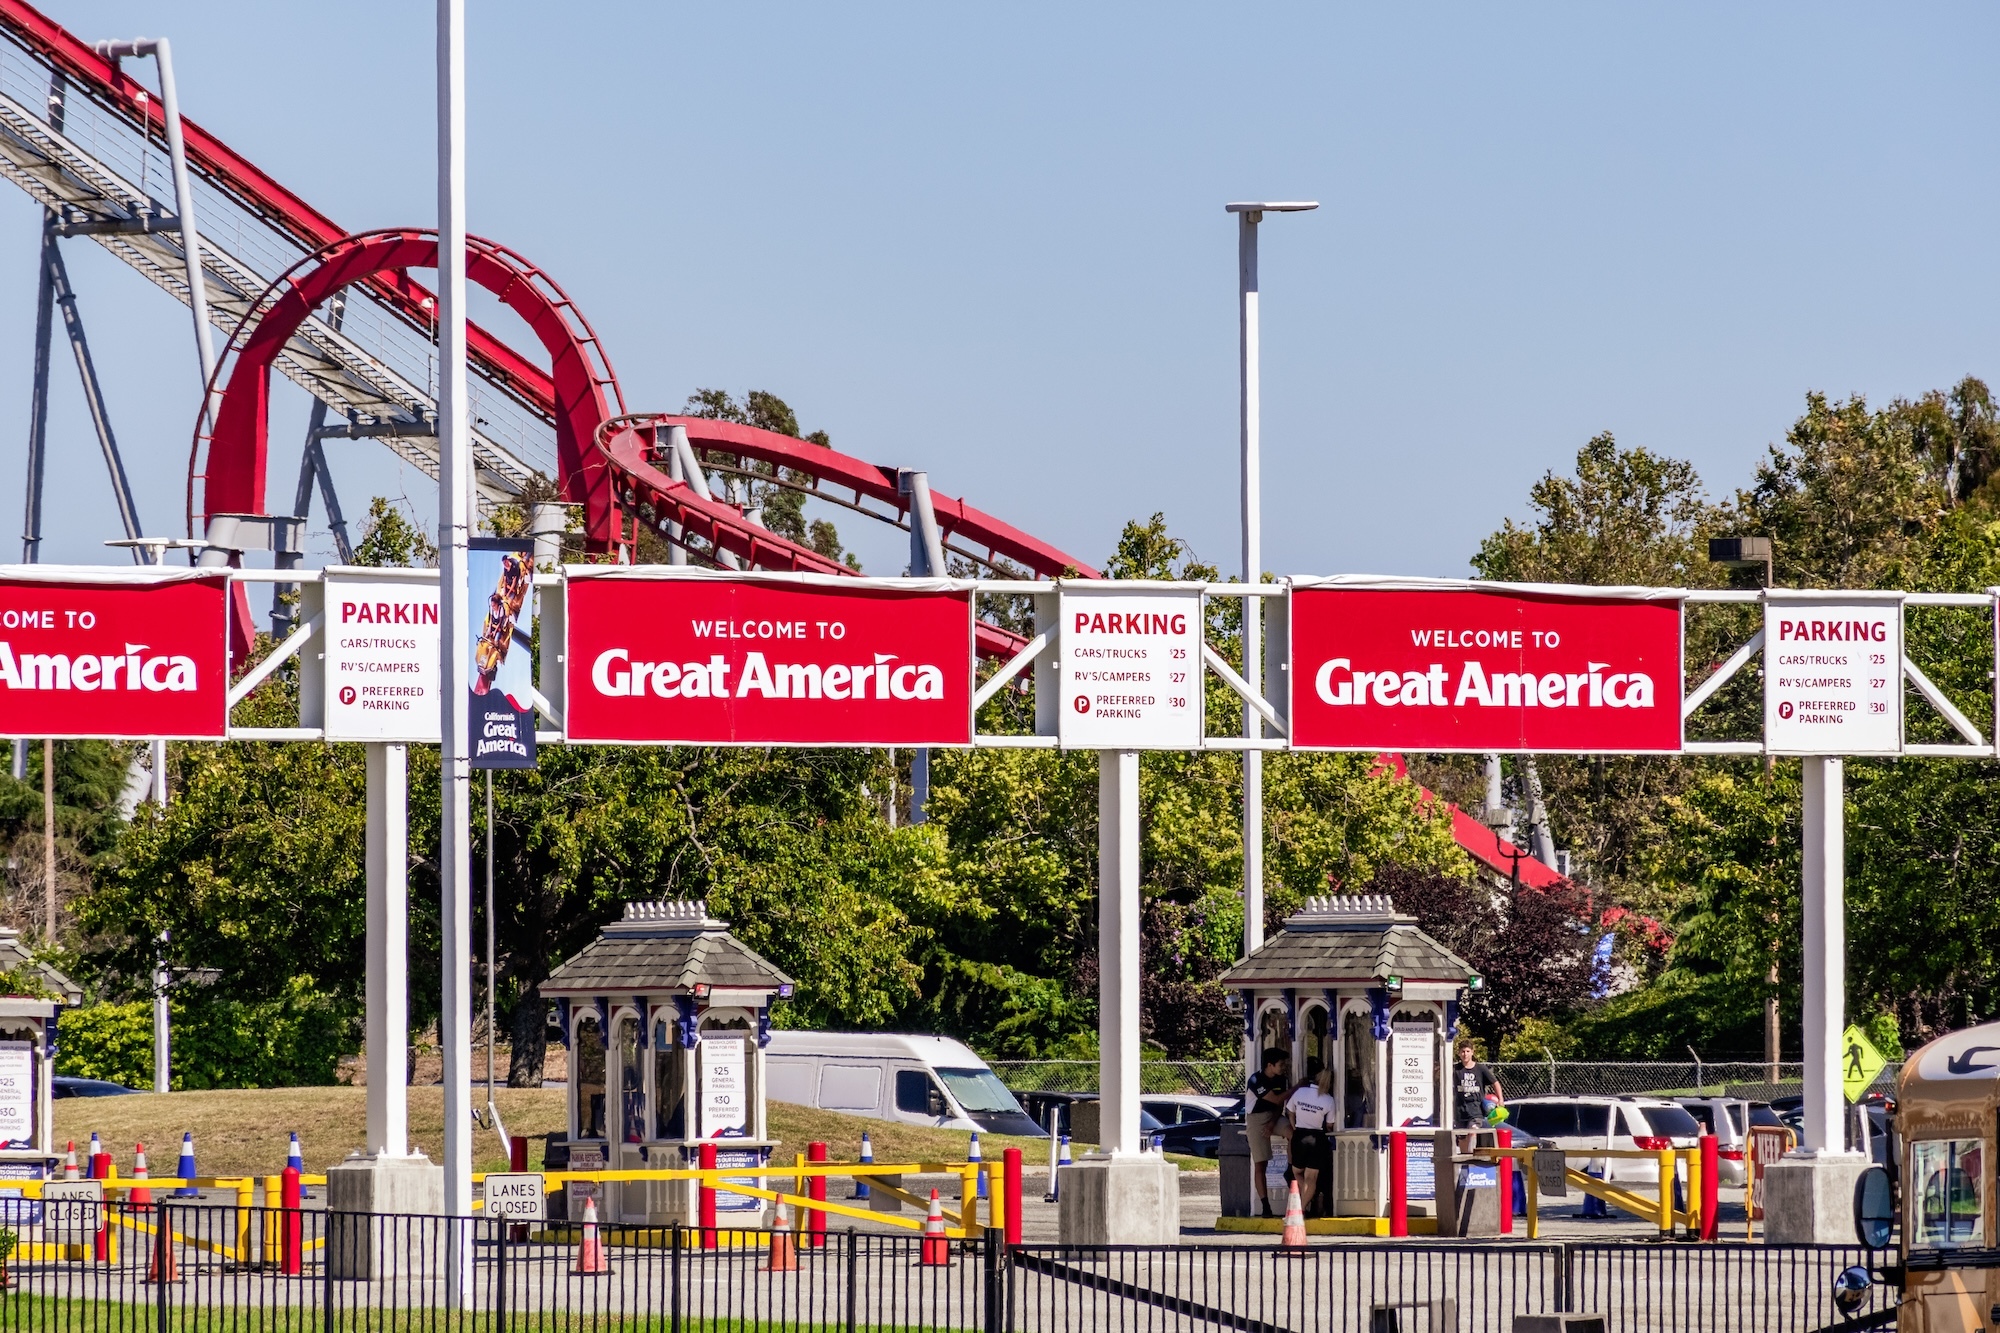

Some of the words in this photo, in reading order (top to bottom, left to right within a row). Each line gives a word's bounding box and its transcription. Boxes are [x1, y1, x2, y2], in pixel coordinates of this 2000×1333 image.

[342, 602, 439, 625] PARKIN
[0, 610, 54, 629] OME
[65, 610, 96, 629] TO
[1075, 613, 1186, 635] PARKING
[691, 620, 806, 639] WELCOME
[816, 621, 846, 640] TO
[1780, 621, 1886, 642] PARKING
[341, 638, 417, 649] CARS/TRUCKS
[1411, 629, 1523, 648] WELCOME
[1532, 631, 1561, 648] TO
[1074, 648, 1148, 659] CARS/TRUCKS
[1169, 649, 1186, 659] $25
[1779, 655, 1848, 665] CARS/TRUCKS
[1869, 654, 1885, 664] $25
[341, 661, 420, 673] RV'S/CAMPERS
[591, 648, 731, 698] Great
[735, 652, 944, 700] America
[1074, 671, 1151, 682] RV'S/CAMPERS
[1169, 672, 1186, 683] $27
[1314, 657, 1449, 706] Great
[1453, 661, 1655, 708] America
[1779, 678, 1851, 688] RV'S/CAMPERS
[1869, 679, 1885, 689] $27
[362, 686, 424, 697] PREFERRED
[362, 700, 410, 710] PARKING
[1096, 695, 1156, 706] PREFERRED
[1169, 697, 1186, 708] $30
[1799, 701, 1856, 711] PREFERRED
[1869, 702, 1885, 712] $30
[484, 711, 515, 722] California's
[1096, 709, 1141, 718] PARKING
[1799, 714, 1843, 724] PARKING
[483, 721, 517, 739] Great
[476, 738, 527, 757] America
[1404, 1058, 1419, 1067] $25
[714, 1067, 729, 1075] $25
[1464, 1072, 1475, 1081] NO
[0, 1078, 15, 1087] $25
[1404, 1086, 1419, 1095] $30
[714, 1095, 730, 1105] $30
[0, 1107, 17, 1117] $30
[1297, 1101, 1324, 1112] SUPERVISOR
[1757, 1133, 1781, 1165] KEEP
[1469, 1172, 1487, 1180] Great
[1467, 1179, 1497, 1187] America
[51, 1190, 93, 1202] LANES
[492, 1184, 536, 1197] LANES
[491, 1201, 538, 1214] CLOSED
